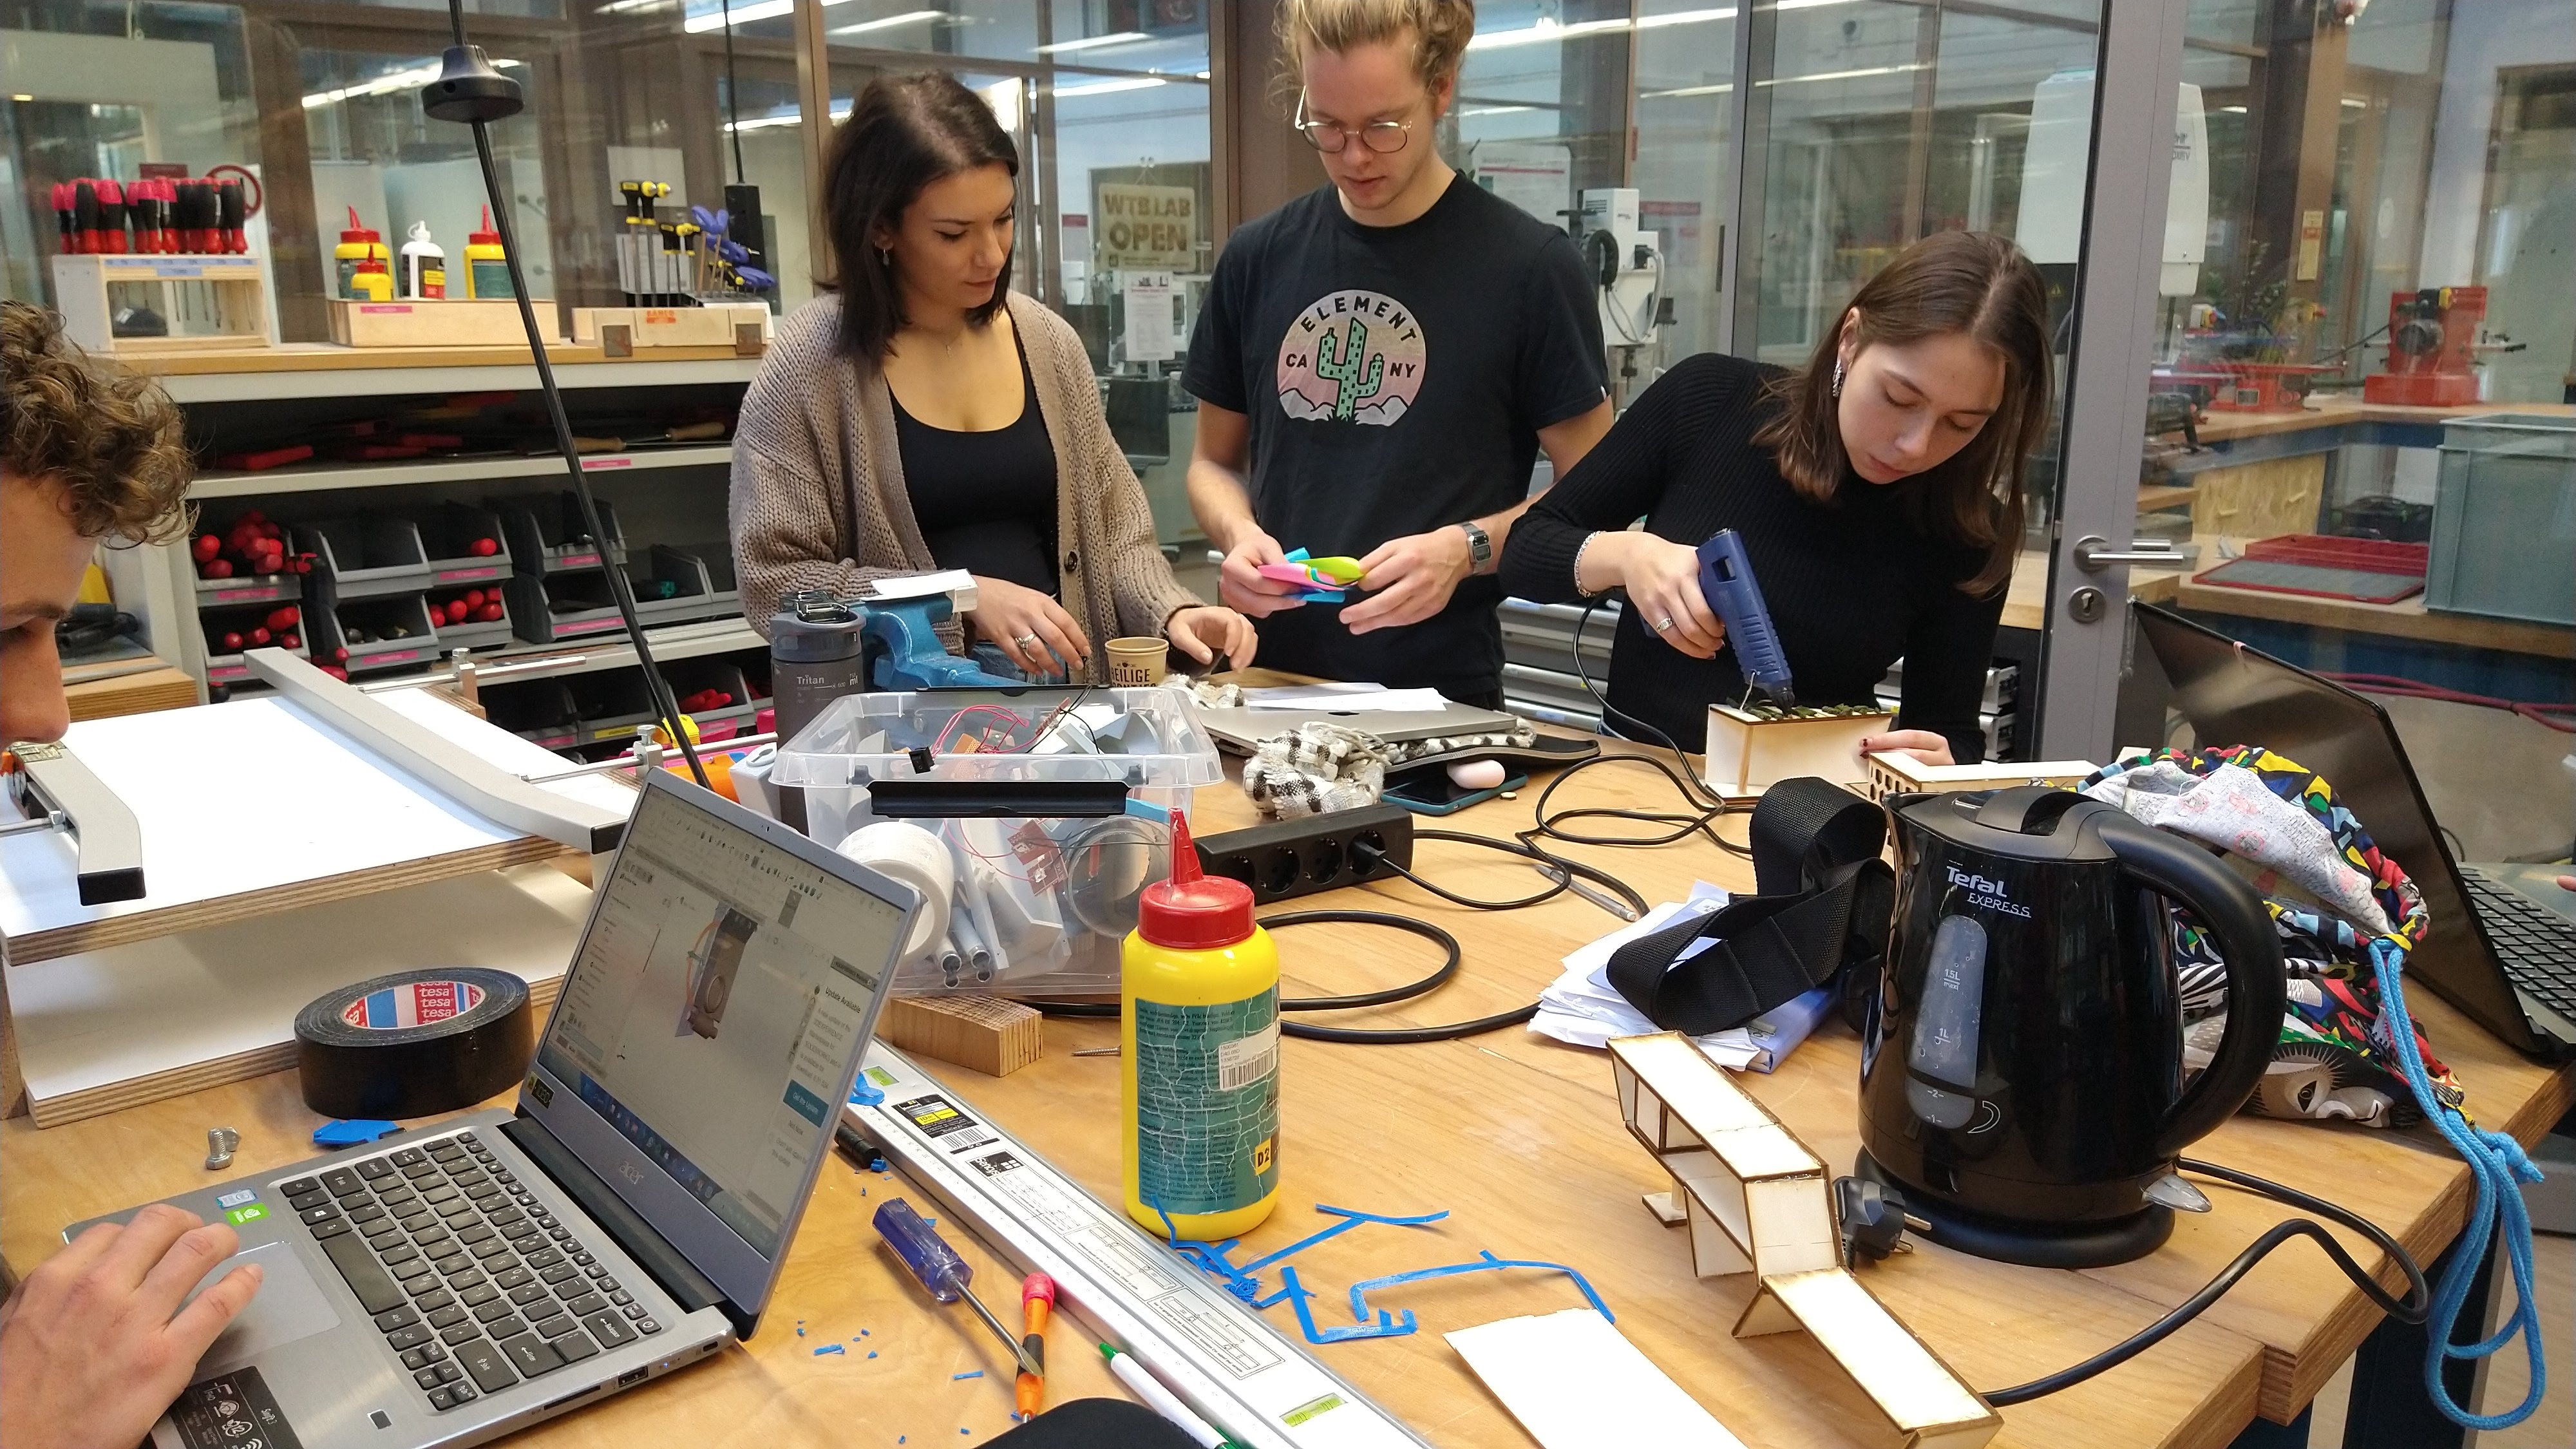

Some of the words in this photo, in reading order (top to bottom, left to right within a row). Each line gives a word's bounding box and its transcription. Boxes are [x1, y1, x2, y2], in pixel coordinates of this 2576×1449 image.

[1109, 222, 1187, 251] OPEN
[1301, 296, 1417, 341] ELEMENT
[1286, 354, 1307, 368] CA
[1390, 363, 1416, 378] NY
[797, 675, 824, 685] Tritan
[1946, 866, 2007, 898] Tefal
[1967, 893, 2032, 918] EXPRESS
[419, 988, 450, 997] tesa
[420, 998, 451, 1007] tesa
[825, 986, 841, 1002] Update
[840, 996, 861, 1014] Available
[421, 1009, 451, 1018] tesa
[1258, 1147, 1270, 1168] D2
[620, 1160, 644, 1186] acer
